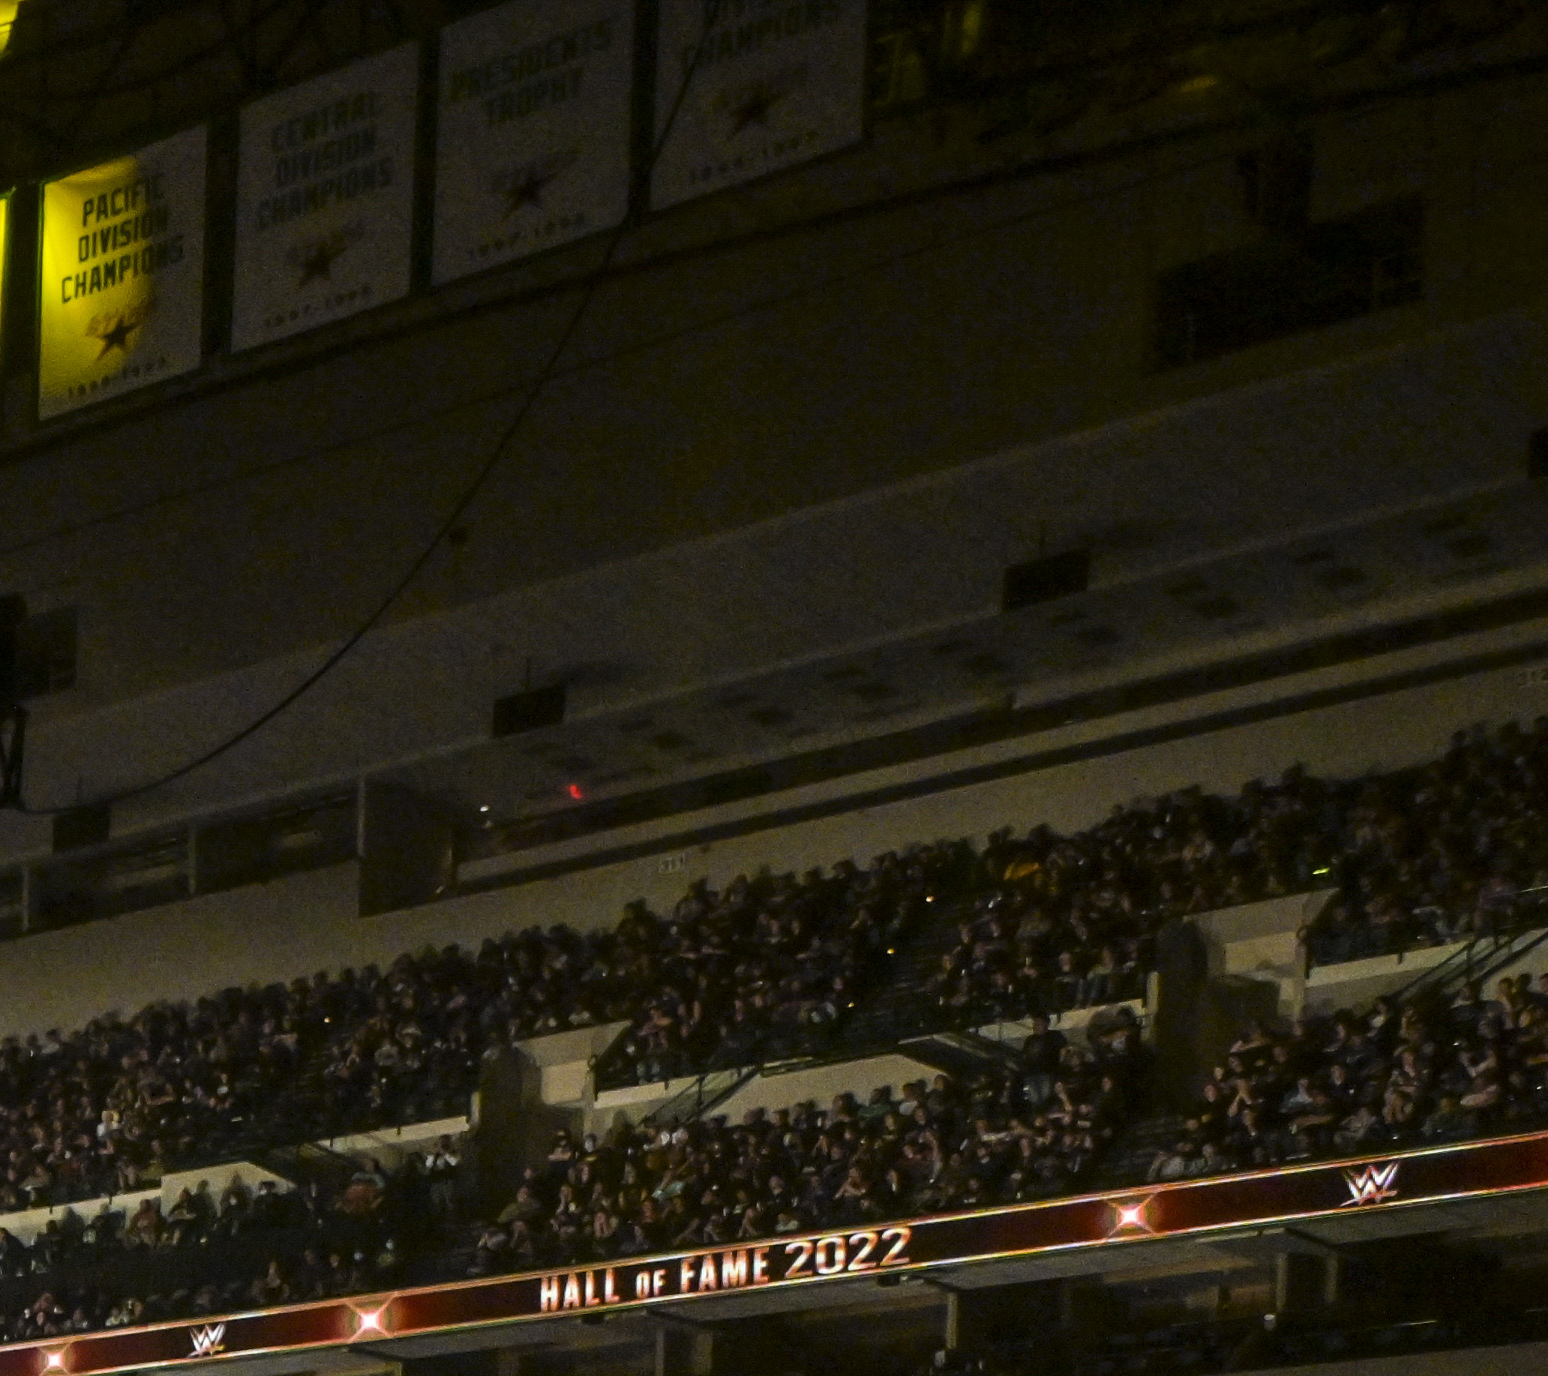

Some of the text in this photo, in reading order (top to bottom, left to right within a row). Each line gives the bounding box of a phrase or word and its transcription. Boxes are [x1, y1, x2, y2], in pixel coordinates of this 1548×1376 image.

[79, 205, 167, 262] DIVISION
[62, 234, 184, 303] CHAMPIONS
[540, 1227, 912, 1312] HALL OF FAME 2022
